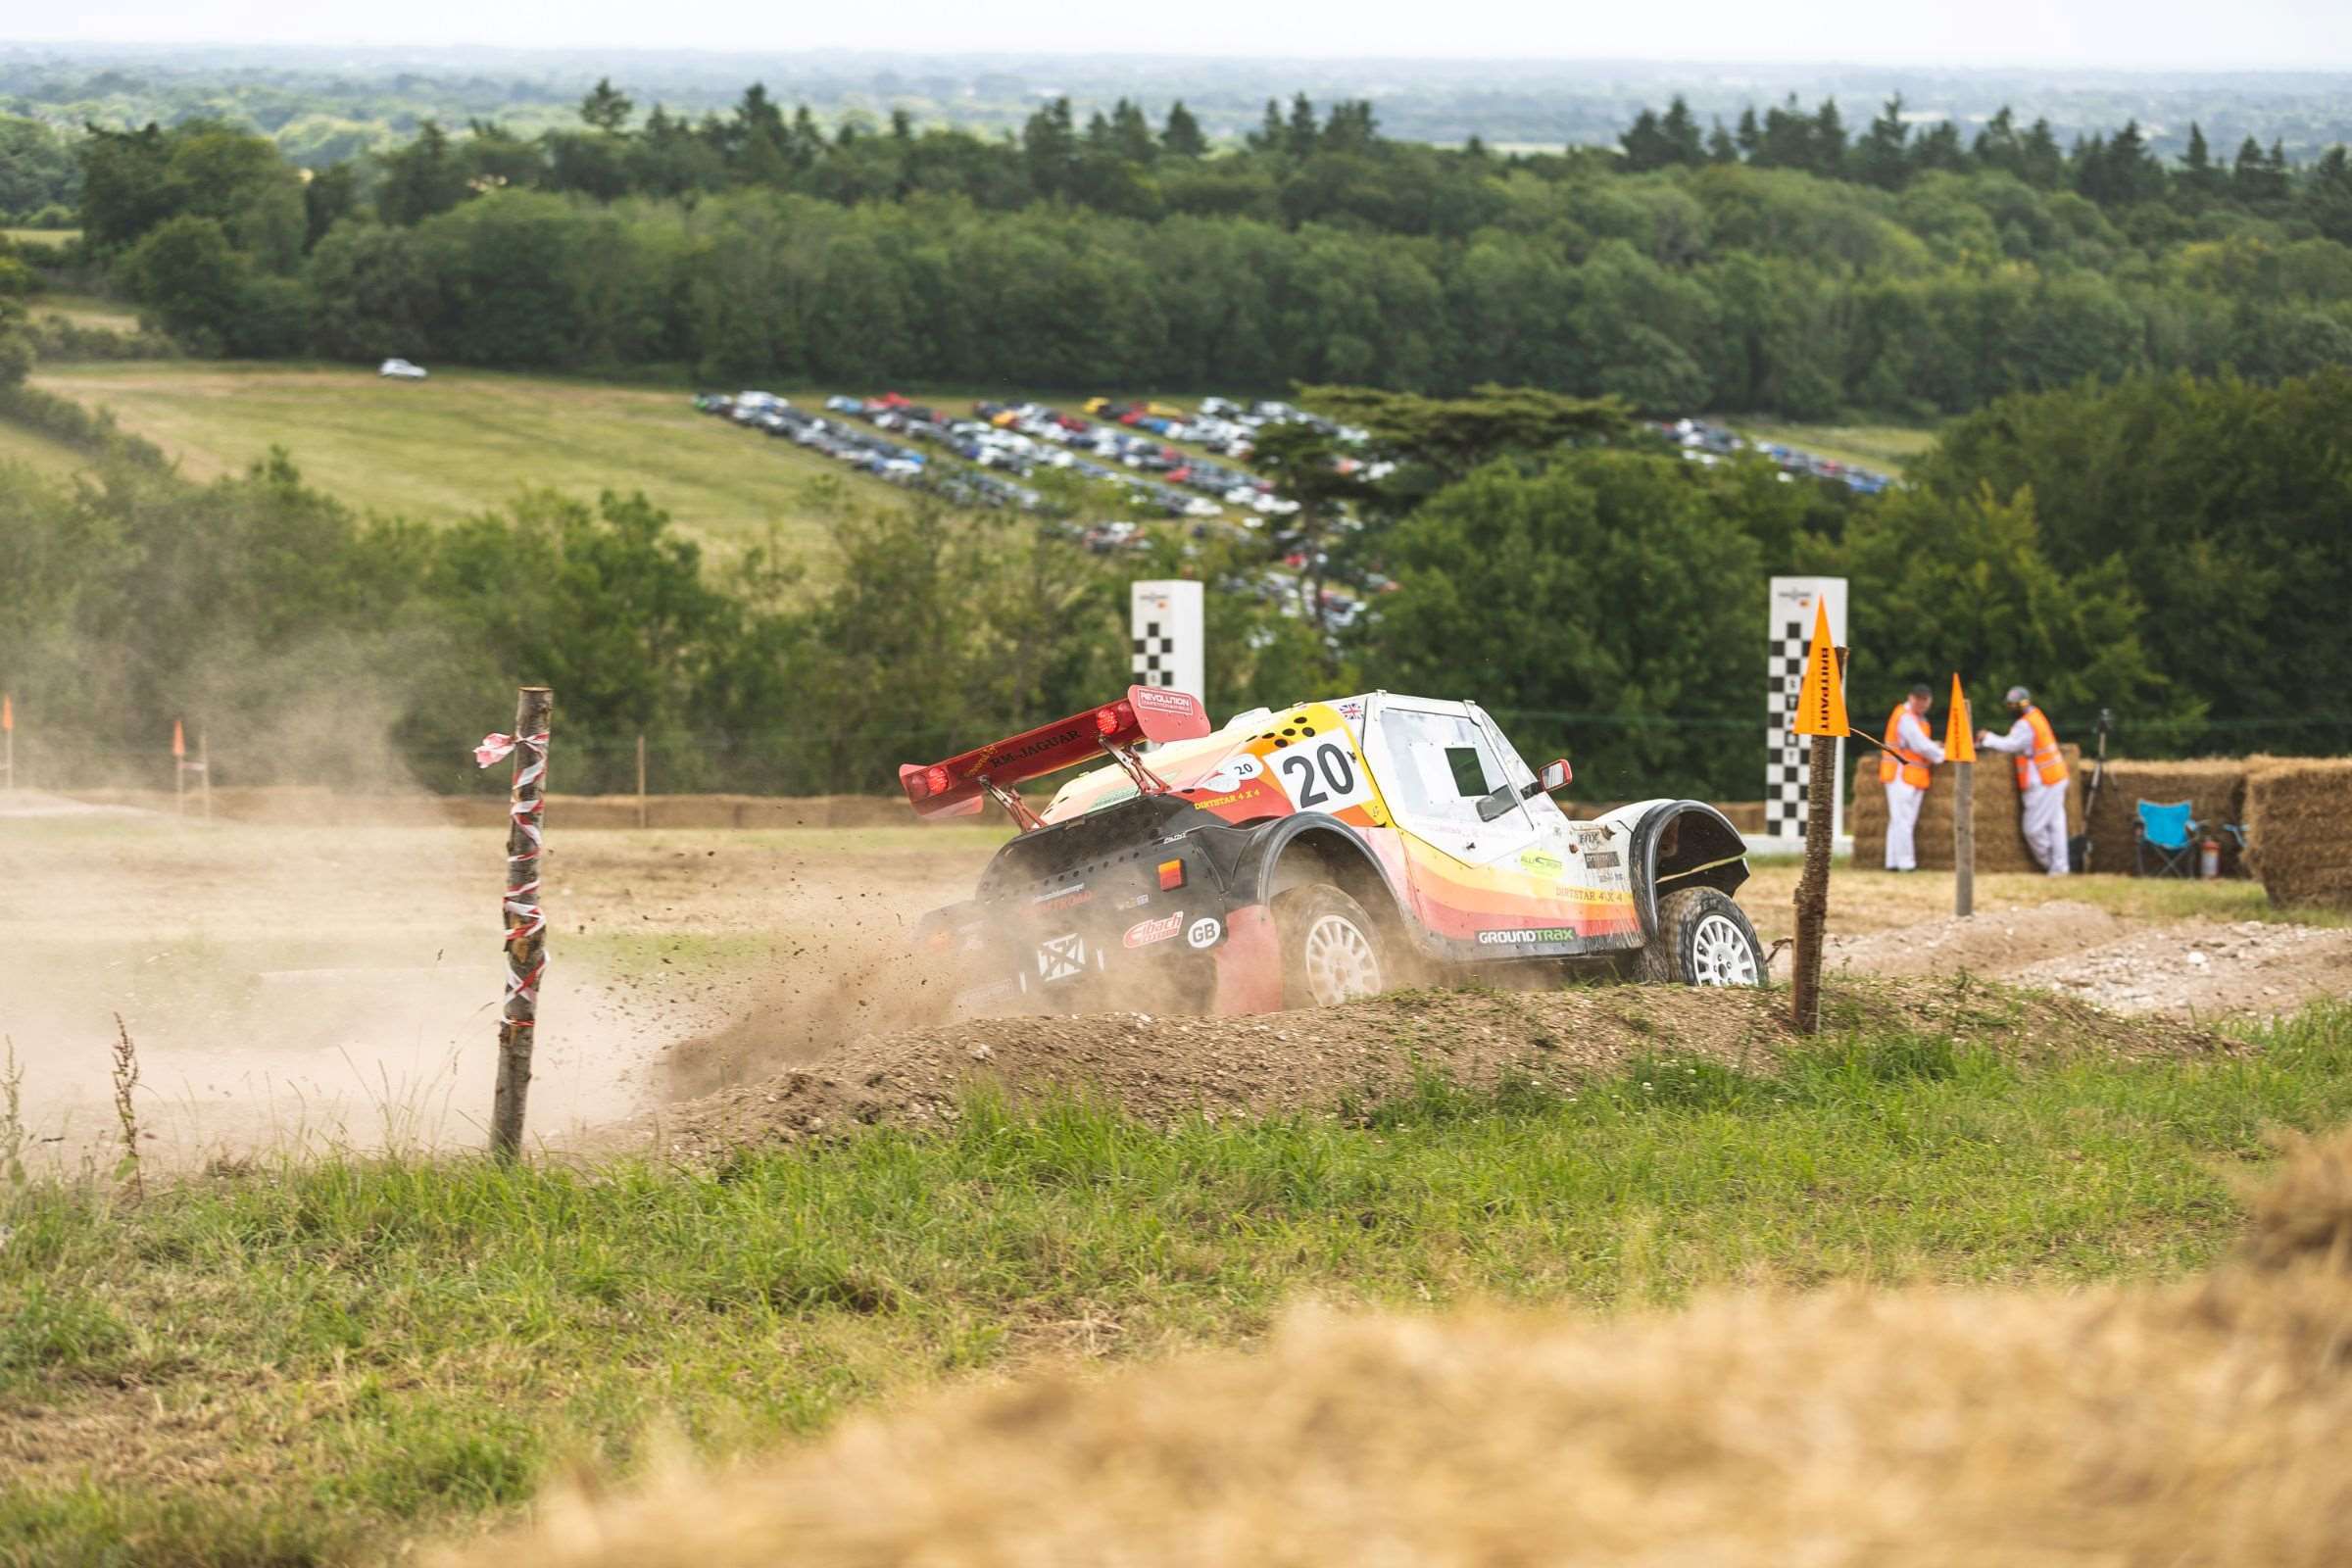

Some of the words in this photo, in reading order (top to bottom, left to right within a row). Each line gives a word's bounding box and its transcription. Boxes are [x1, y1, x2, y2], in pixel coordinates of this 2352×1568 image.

[1140, 691, 1190, 707] REVOLUTION
[1018, 730, 1082, 759] JAGUAR
[1233, 762, 1253, 776] 20
[1282, 743, 1354, 808] 20
[1555, 886, 1595, 902] DIRTSTAR
[1193, 922, 1216, 943] GB
